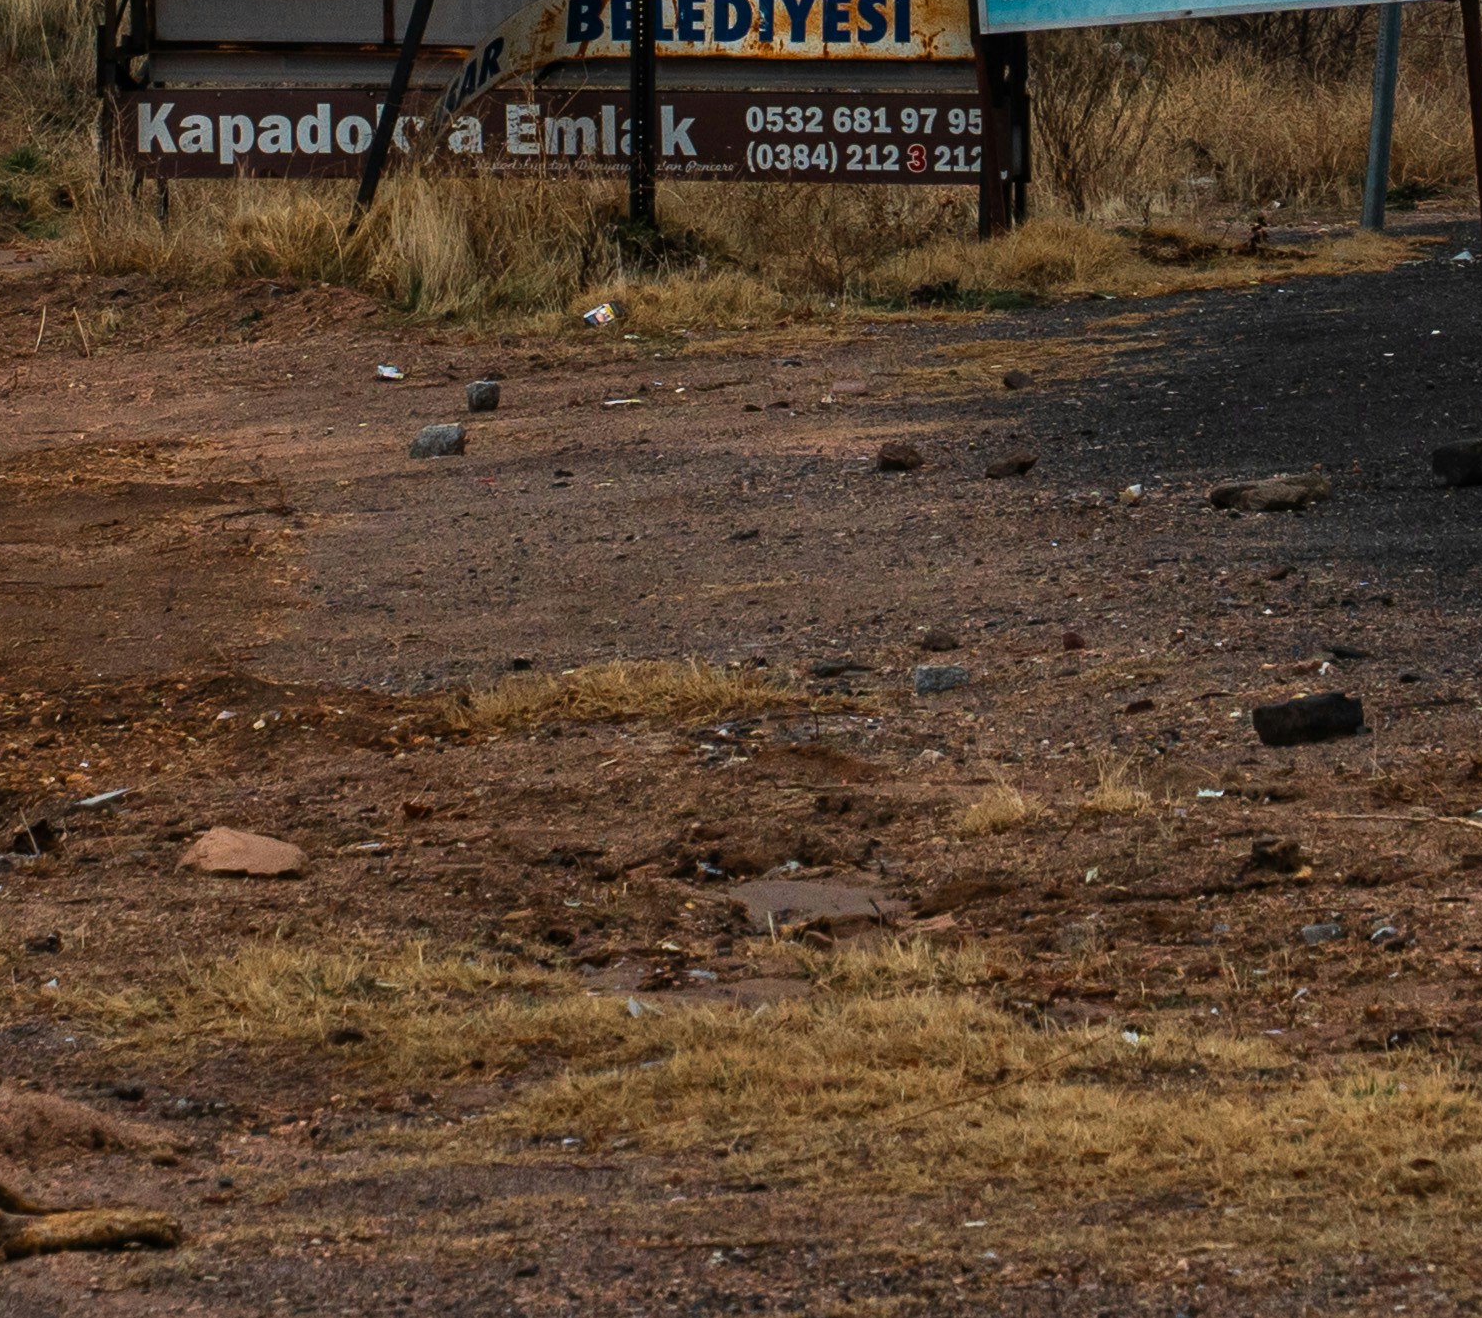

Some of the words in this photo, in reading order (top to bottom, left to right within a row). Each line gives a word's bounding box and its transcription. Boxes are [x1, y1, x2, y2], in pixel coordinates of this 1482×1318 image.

[745, 106, 823, 133] 0532
[833, 106, 892, 134] 681
[900, 107, 937, 134] 97
[947, 108, 982, 134] 95
[746, 141, 838, 173] (0384)
[846, 144, 900, 171] 212
[906, 143, 927, 173] 3
[934, 145, 982, 172] 212
